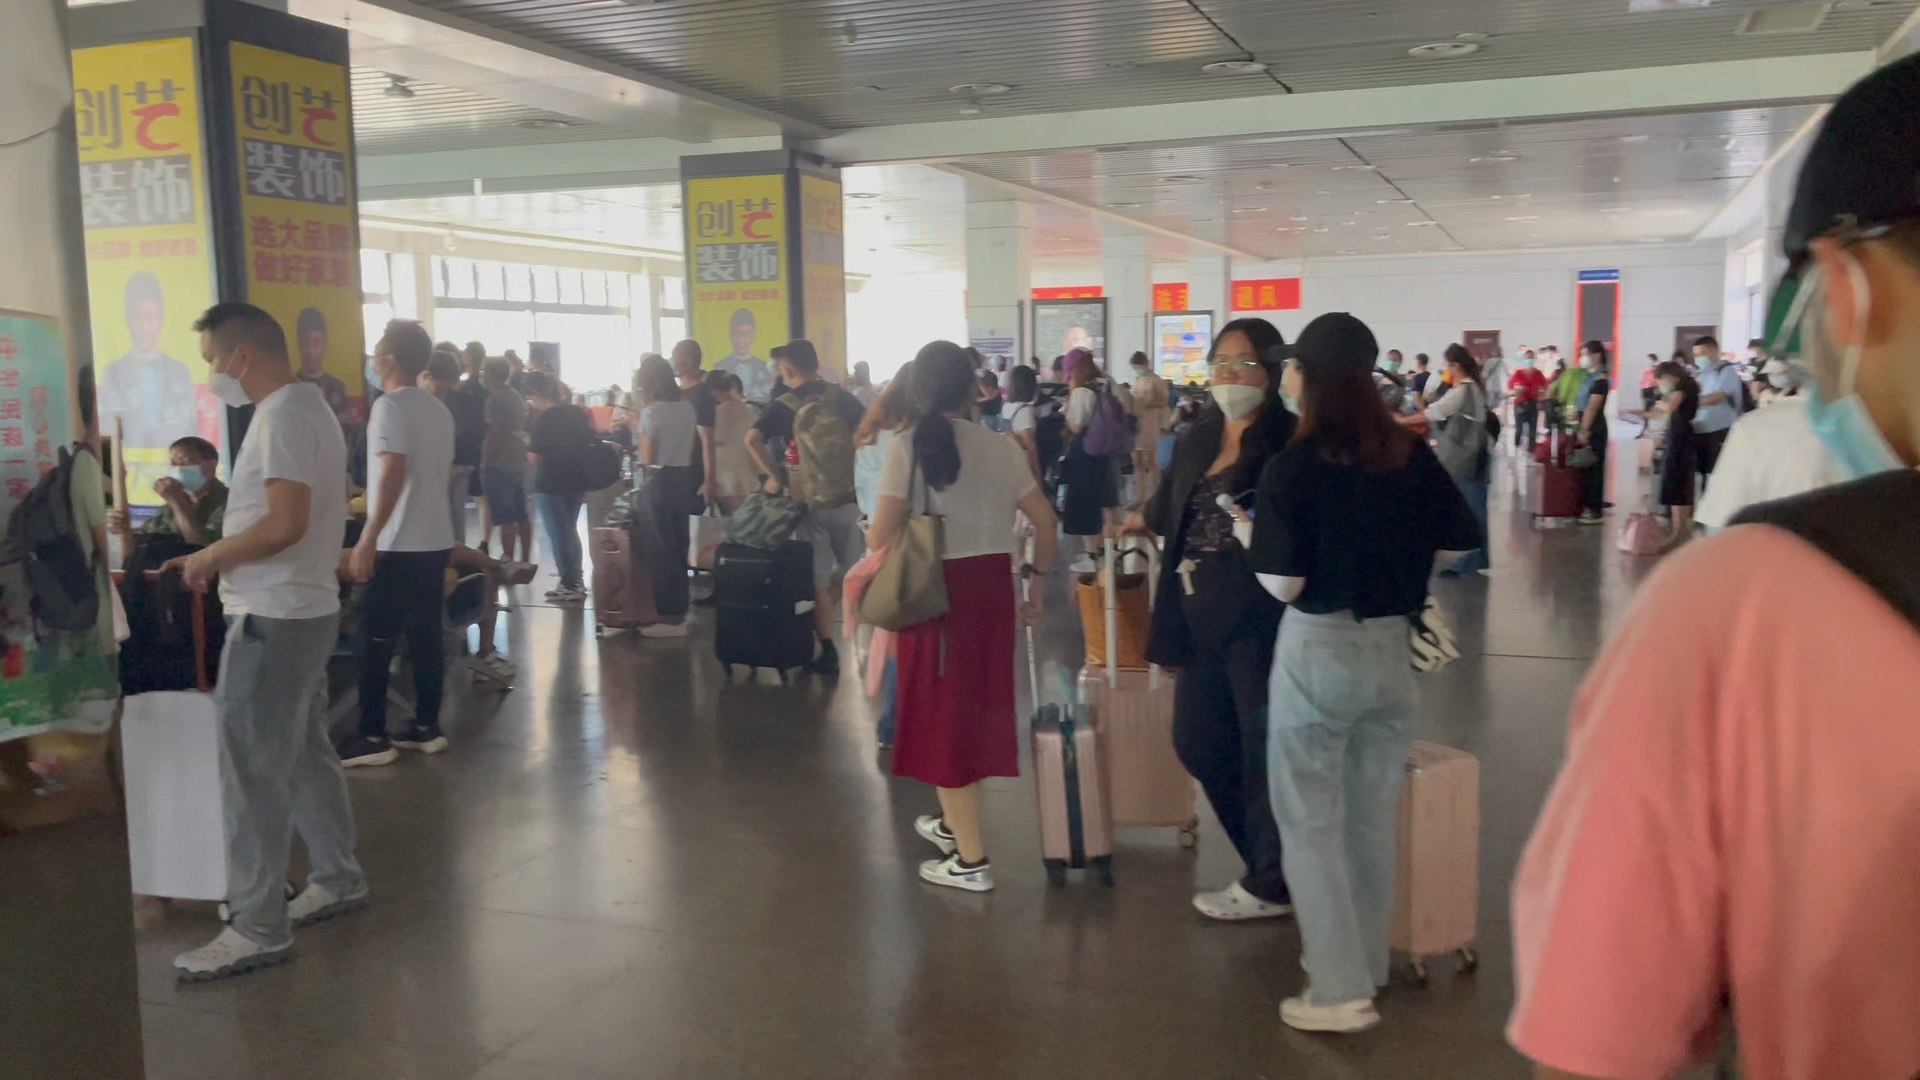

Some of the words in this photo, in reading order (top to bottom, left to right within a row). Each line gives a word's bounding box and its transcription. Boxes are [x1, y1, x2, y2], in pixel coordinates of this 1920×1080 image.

[75, 79, 187, 152] 创艺
[240, 73, 342, 147] 创艺
[80, 159, 191, 225] 装饰
[245, 140, 346, 204] 装饰
[695, 197, 778, 240] 创艺
[696, 243, 778, 282] 装饰
